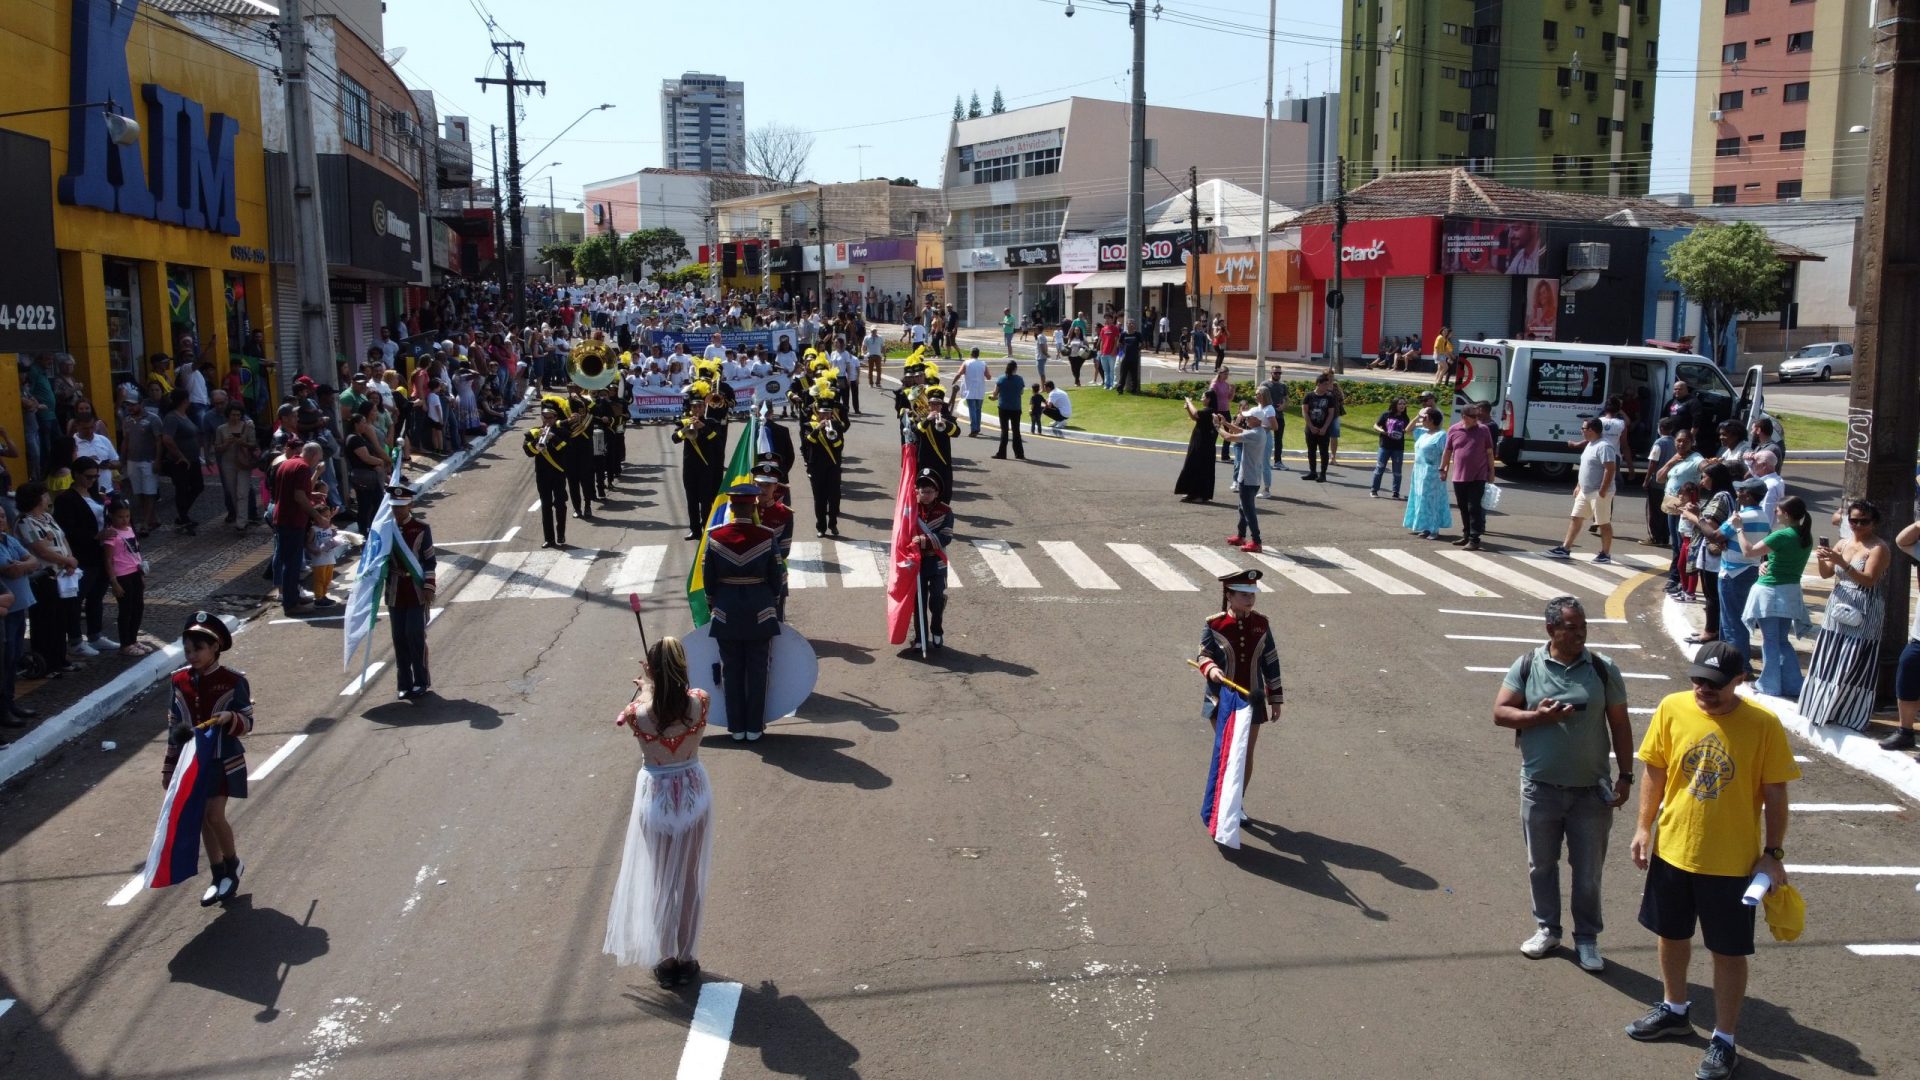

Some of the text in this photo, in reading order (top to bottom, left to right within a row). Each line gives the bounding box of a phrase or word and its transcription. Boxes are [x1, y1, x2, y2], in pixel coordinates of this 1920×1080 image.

[58, 0, 240, 237] KIM
[1004, 145, 1015, 154] de
[852, 246, 868, 258] vivo
[1101, 240, 1173, 262] LOJS 10
[1341, 239, 1386, 262] Claro
[1462, 343, 1503, 356] ÂNCIA
[1687, 749, 1730, 773] WARRIORS
